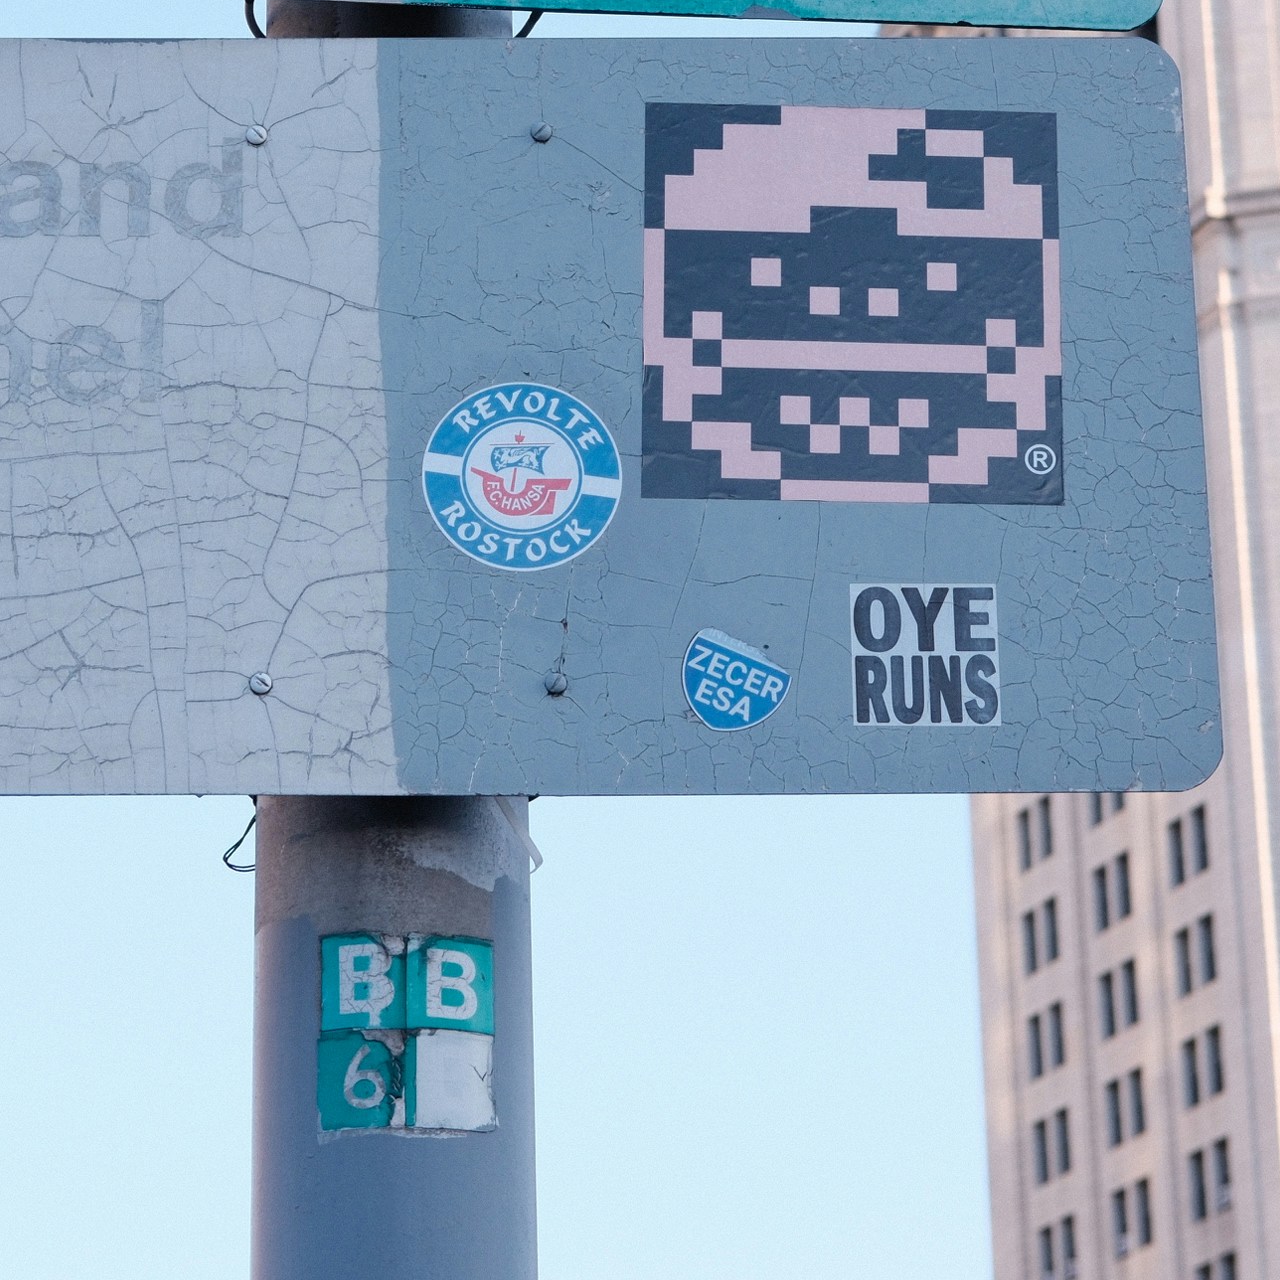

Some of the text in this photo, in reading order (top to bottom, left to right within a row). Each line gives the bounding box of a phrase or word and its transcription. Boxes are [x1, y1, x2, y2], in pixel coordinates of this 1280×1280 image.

[452, 388, 605, 451] REVOLTE
[440, 500, 592, 562] ROSTOCK
[853, 586, 996, 652] OYE
[687, 644, 784, 704] ZECER
[694, 677, 751, 722] ESA
[854, 654, 999, 725] RUNS
[343, 1044, 388, 1109] 6
